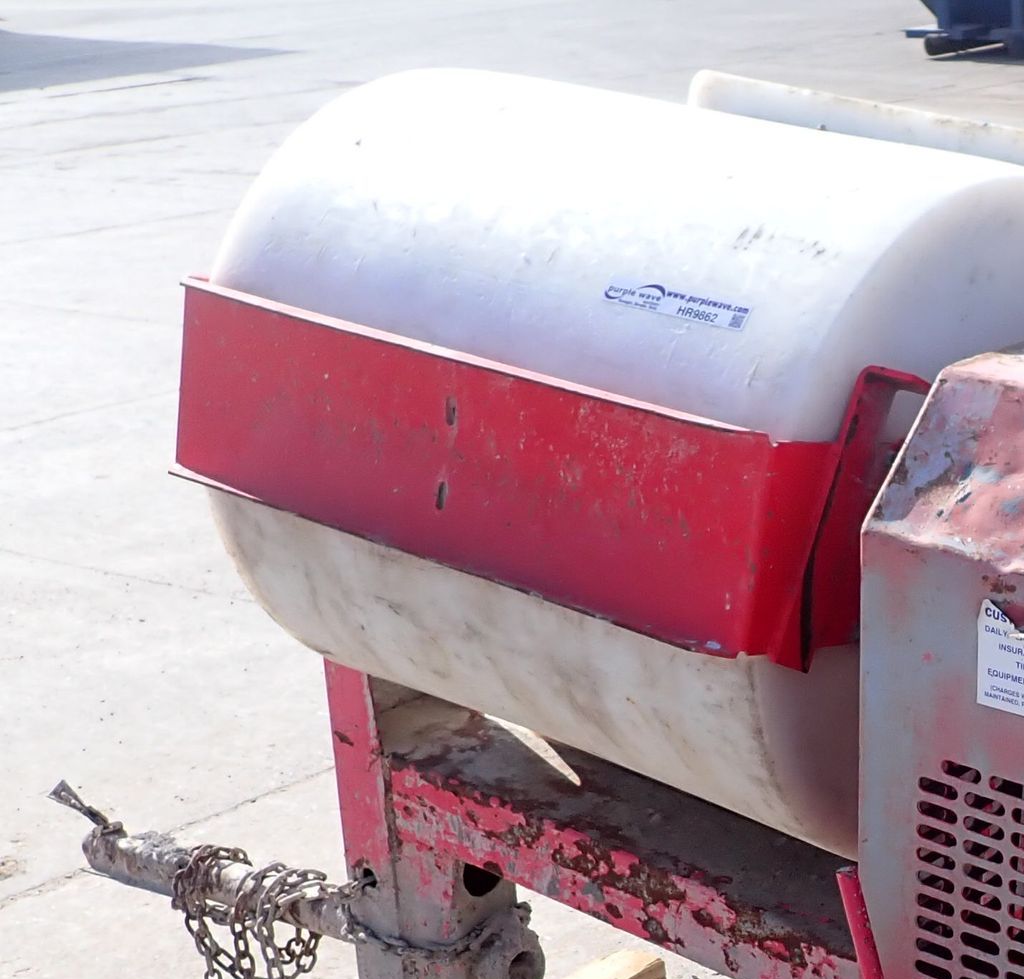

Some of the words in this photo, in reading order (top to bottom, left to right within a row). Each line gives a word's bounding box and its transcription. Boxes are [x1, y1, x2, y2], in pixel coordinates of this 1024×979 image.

[607, 285, 636, 297] purple
[638, 292, 662, 302] wave
[666, 290, 749, 314] www.purplewave.com
[984, 606, 1008, 623] CUS
[984, 625, 1008, 638] DAILY
